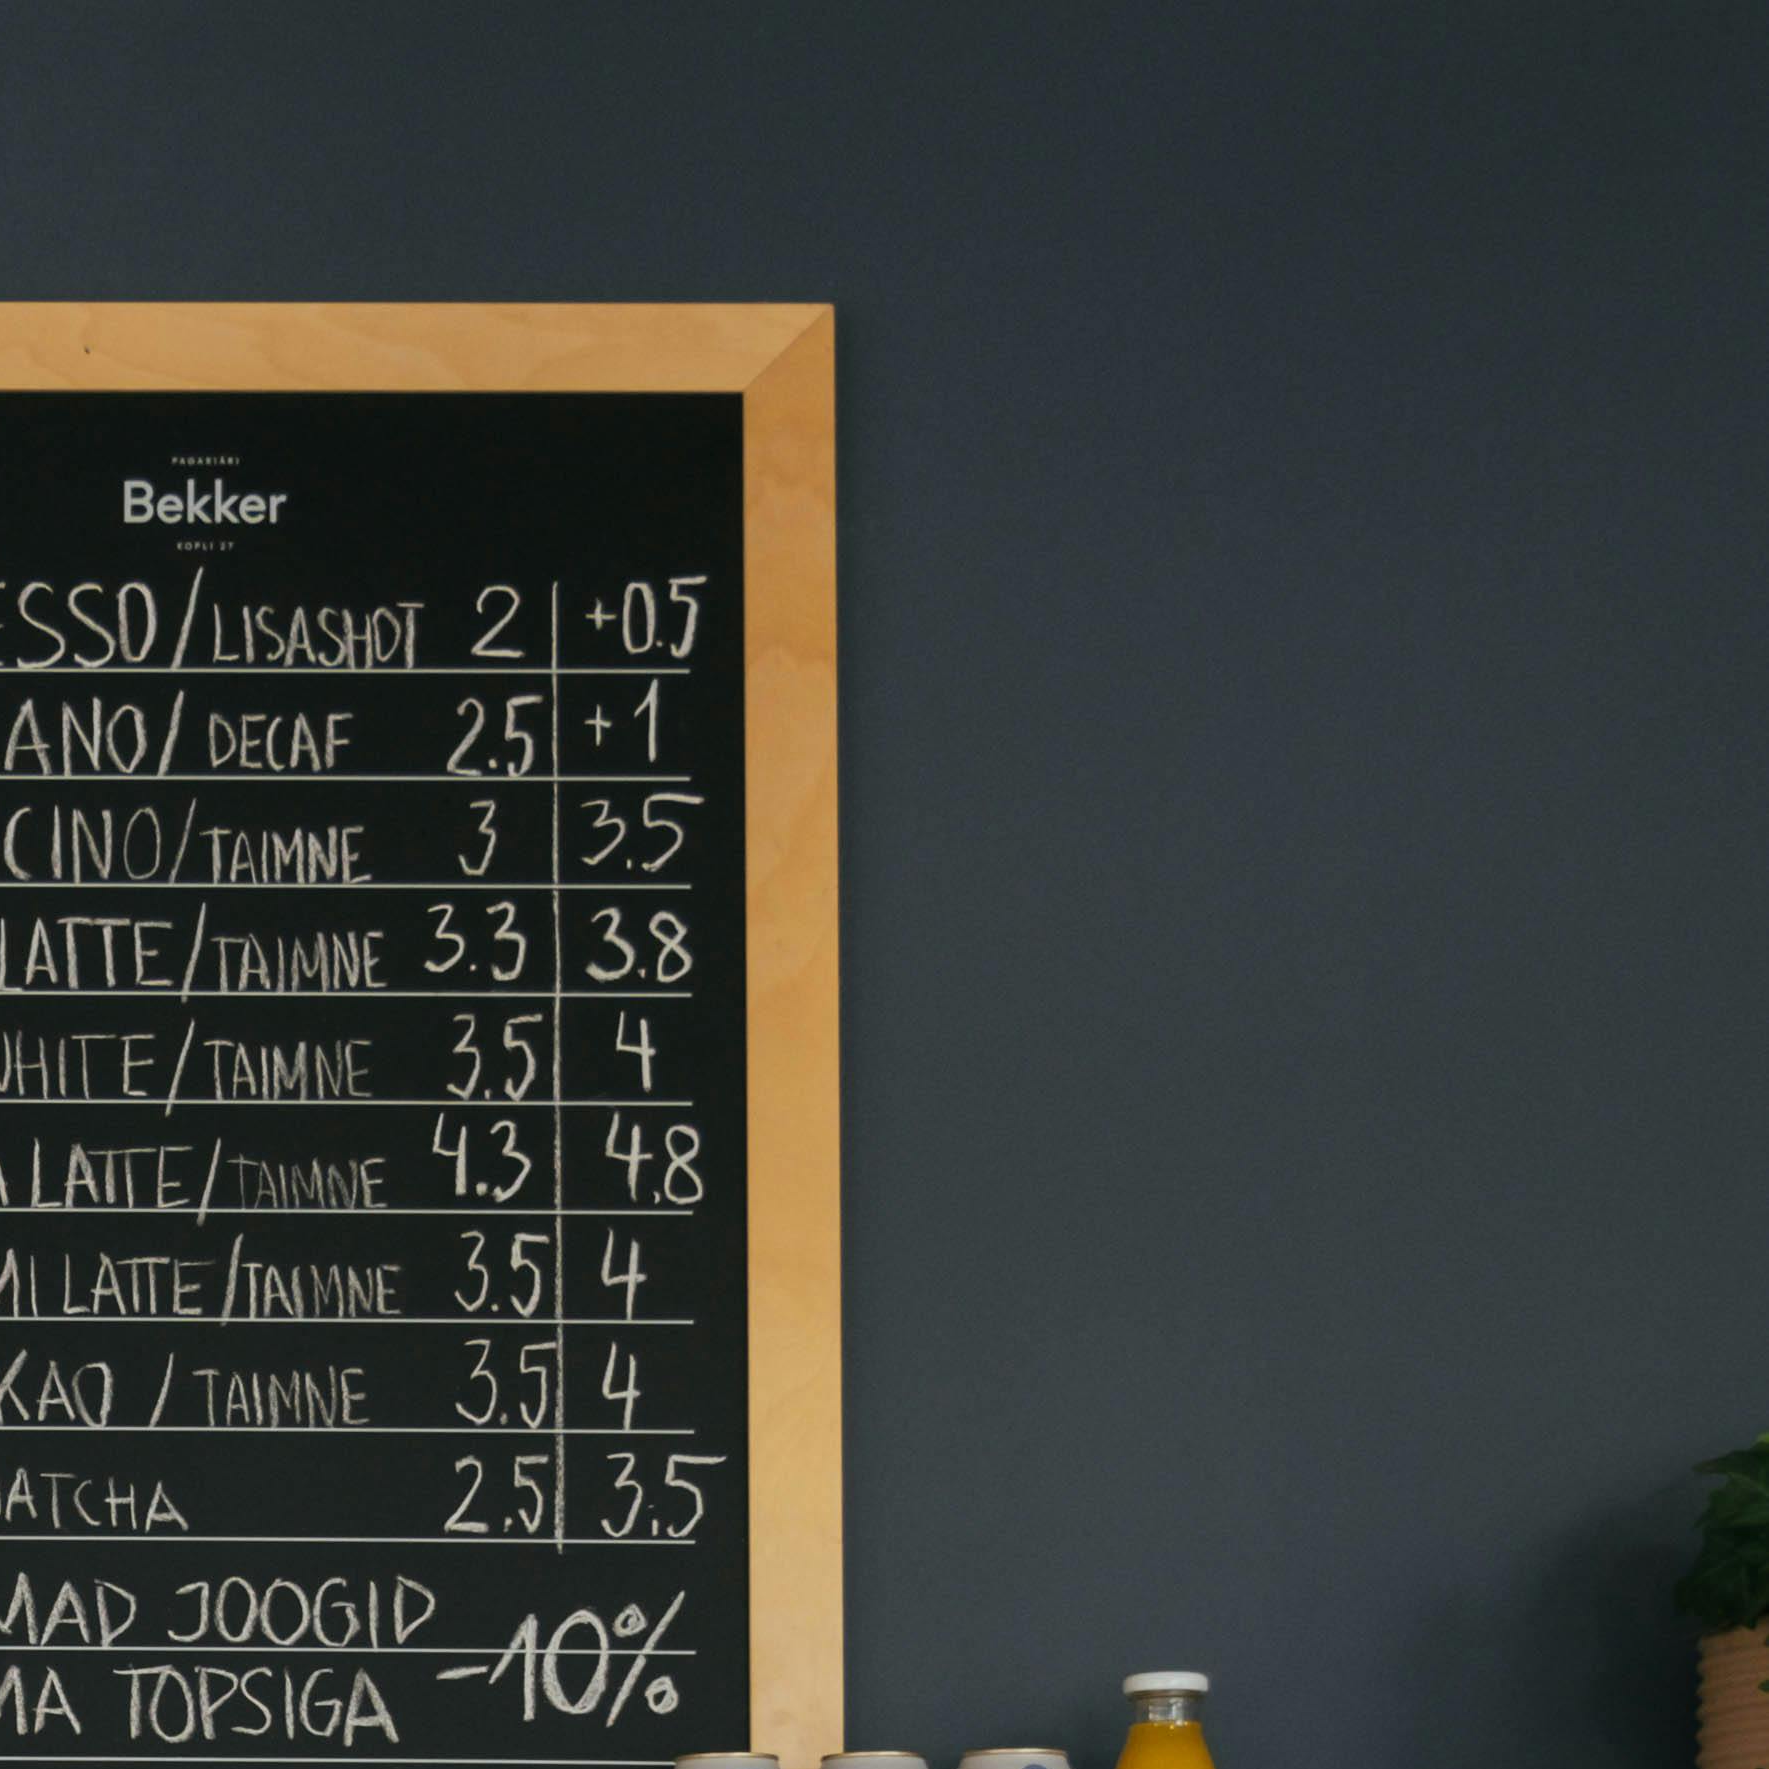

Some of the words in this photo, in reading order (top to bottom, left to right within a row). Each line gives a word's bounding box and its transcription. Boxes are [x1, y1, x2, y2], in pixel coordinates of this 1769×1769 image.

[123, 478, 287, 524] Bekker
[469, 585, 523, 659] 2
[585, 575, 708, 659] +0.5
[208, 712, 354, 771] DECAF
[446, 693, 544, 777] 2.5
[457, 800, 498, 875] 3
[581, 793, 705, 873] 3.5
[423, 903, 528, 985] 3.3
[584, 906, 693, 984] 3.8
[445, 1012, 544, 1100] 3.5
[615, 1011, 657, 1092] 4
[431, 1112, 532, 1202] 4.3
[604, 1113, 705, 1206] 4.8
[454, 1230, 550, 1316] 3.5
[601, 1232, 646, 1319] 4
[193, 1367, 367, 1429] TAIMNE
[454, 1337, 559, 1428] 3.5
[601, 1343, 641, 1430] 4
[443, 1454, 548, 1534] 2.5
[601, 1452, 727, 1539] 3.5
[168, 1574, 436, 1648] JOOGID
[436, 1590, 686, 1728] -10%
[113, 1664, 400, 1745] TOPSIGA
